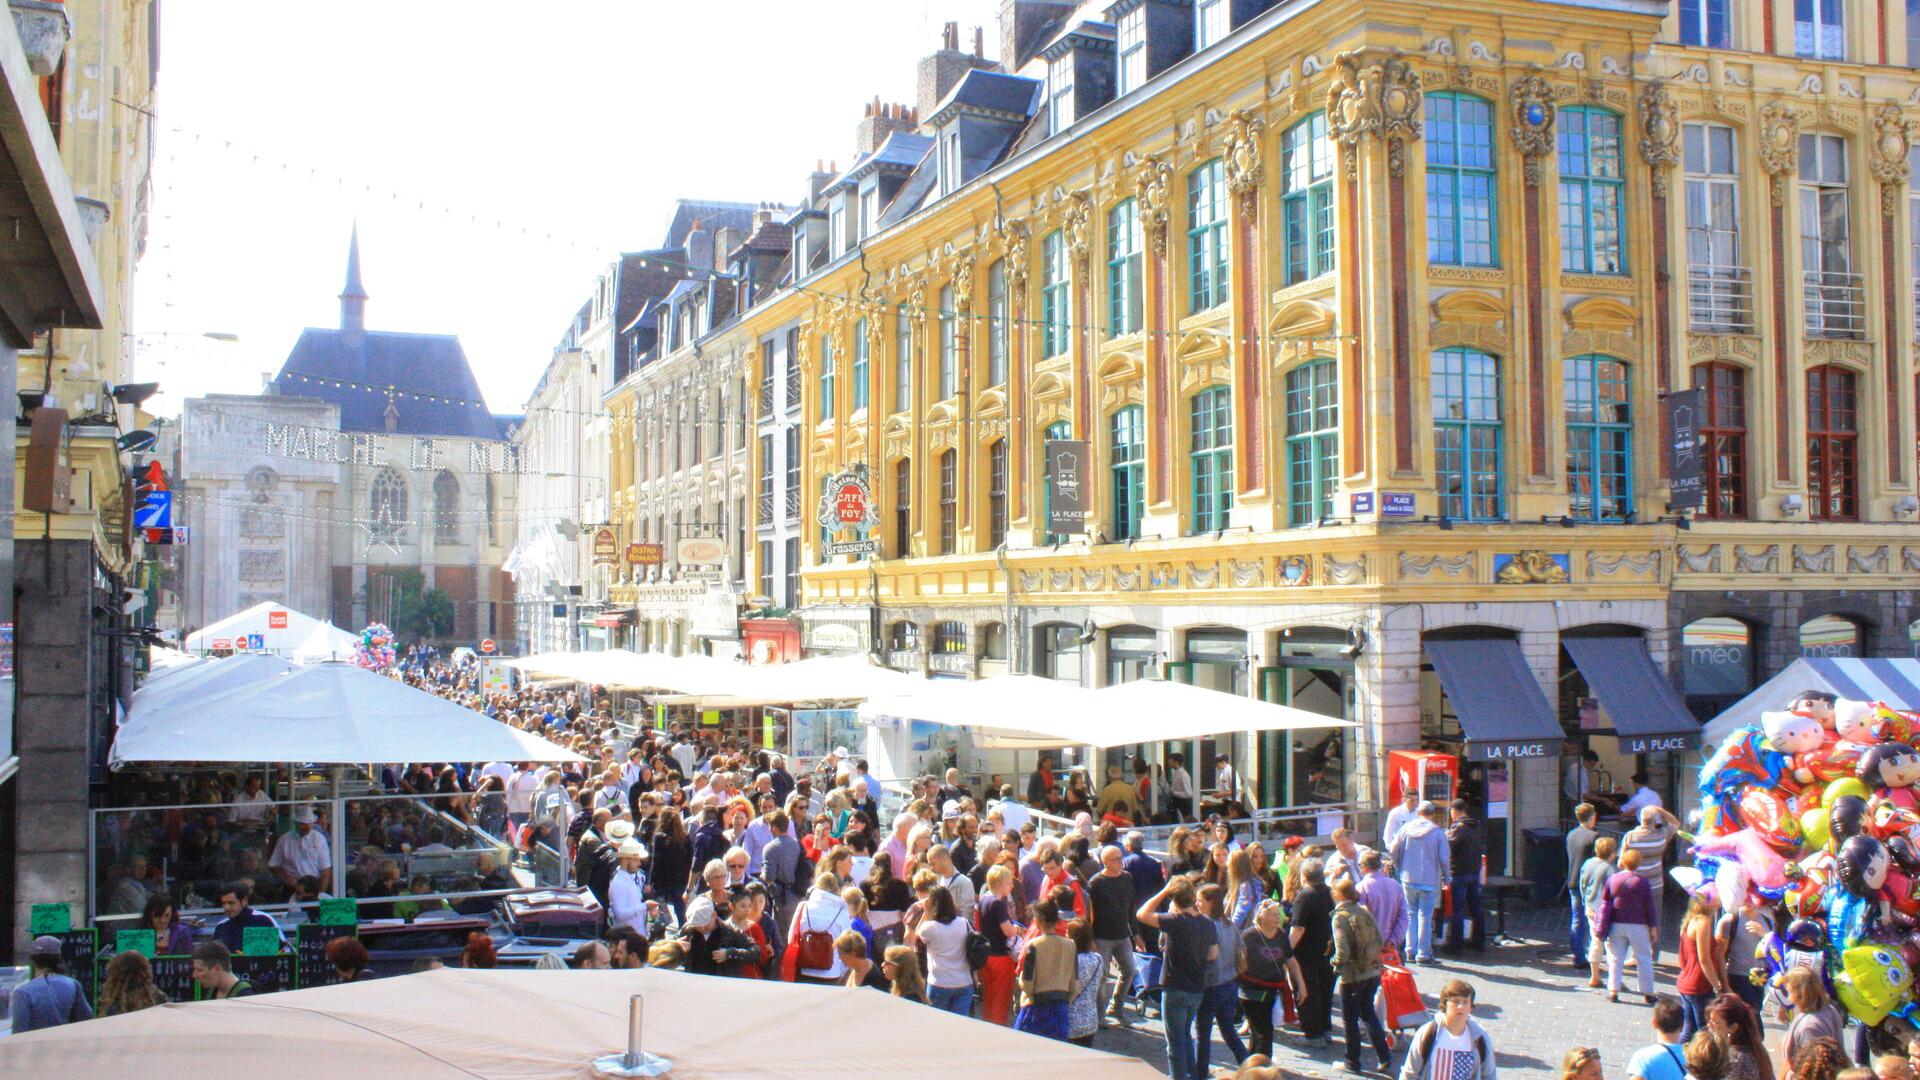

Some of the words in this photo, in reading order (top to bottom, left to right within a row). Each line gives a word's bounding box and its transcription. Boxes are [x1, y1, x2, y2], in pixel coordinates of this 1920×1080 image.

[410, 437, 449, 471] DE
[832, 475, 870, 494] Heineken
[1671, 480, 1679, 489] LA
[1680, 476, 1700, 487] PLACE
[841, 509, 861, 519] FOY
[1051, 510, 1061, 518] LA
[1063, 510, 1084, 519] PLACE
[824, 541, 874, 556] Brasserie
[1487, 746, 1502, 758] LA
[1507, 744, 1545, 757] PLACE
[1632, 740, 1646, 752] LA
[1650, 738, 1685, 751] PLACE
